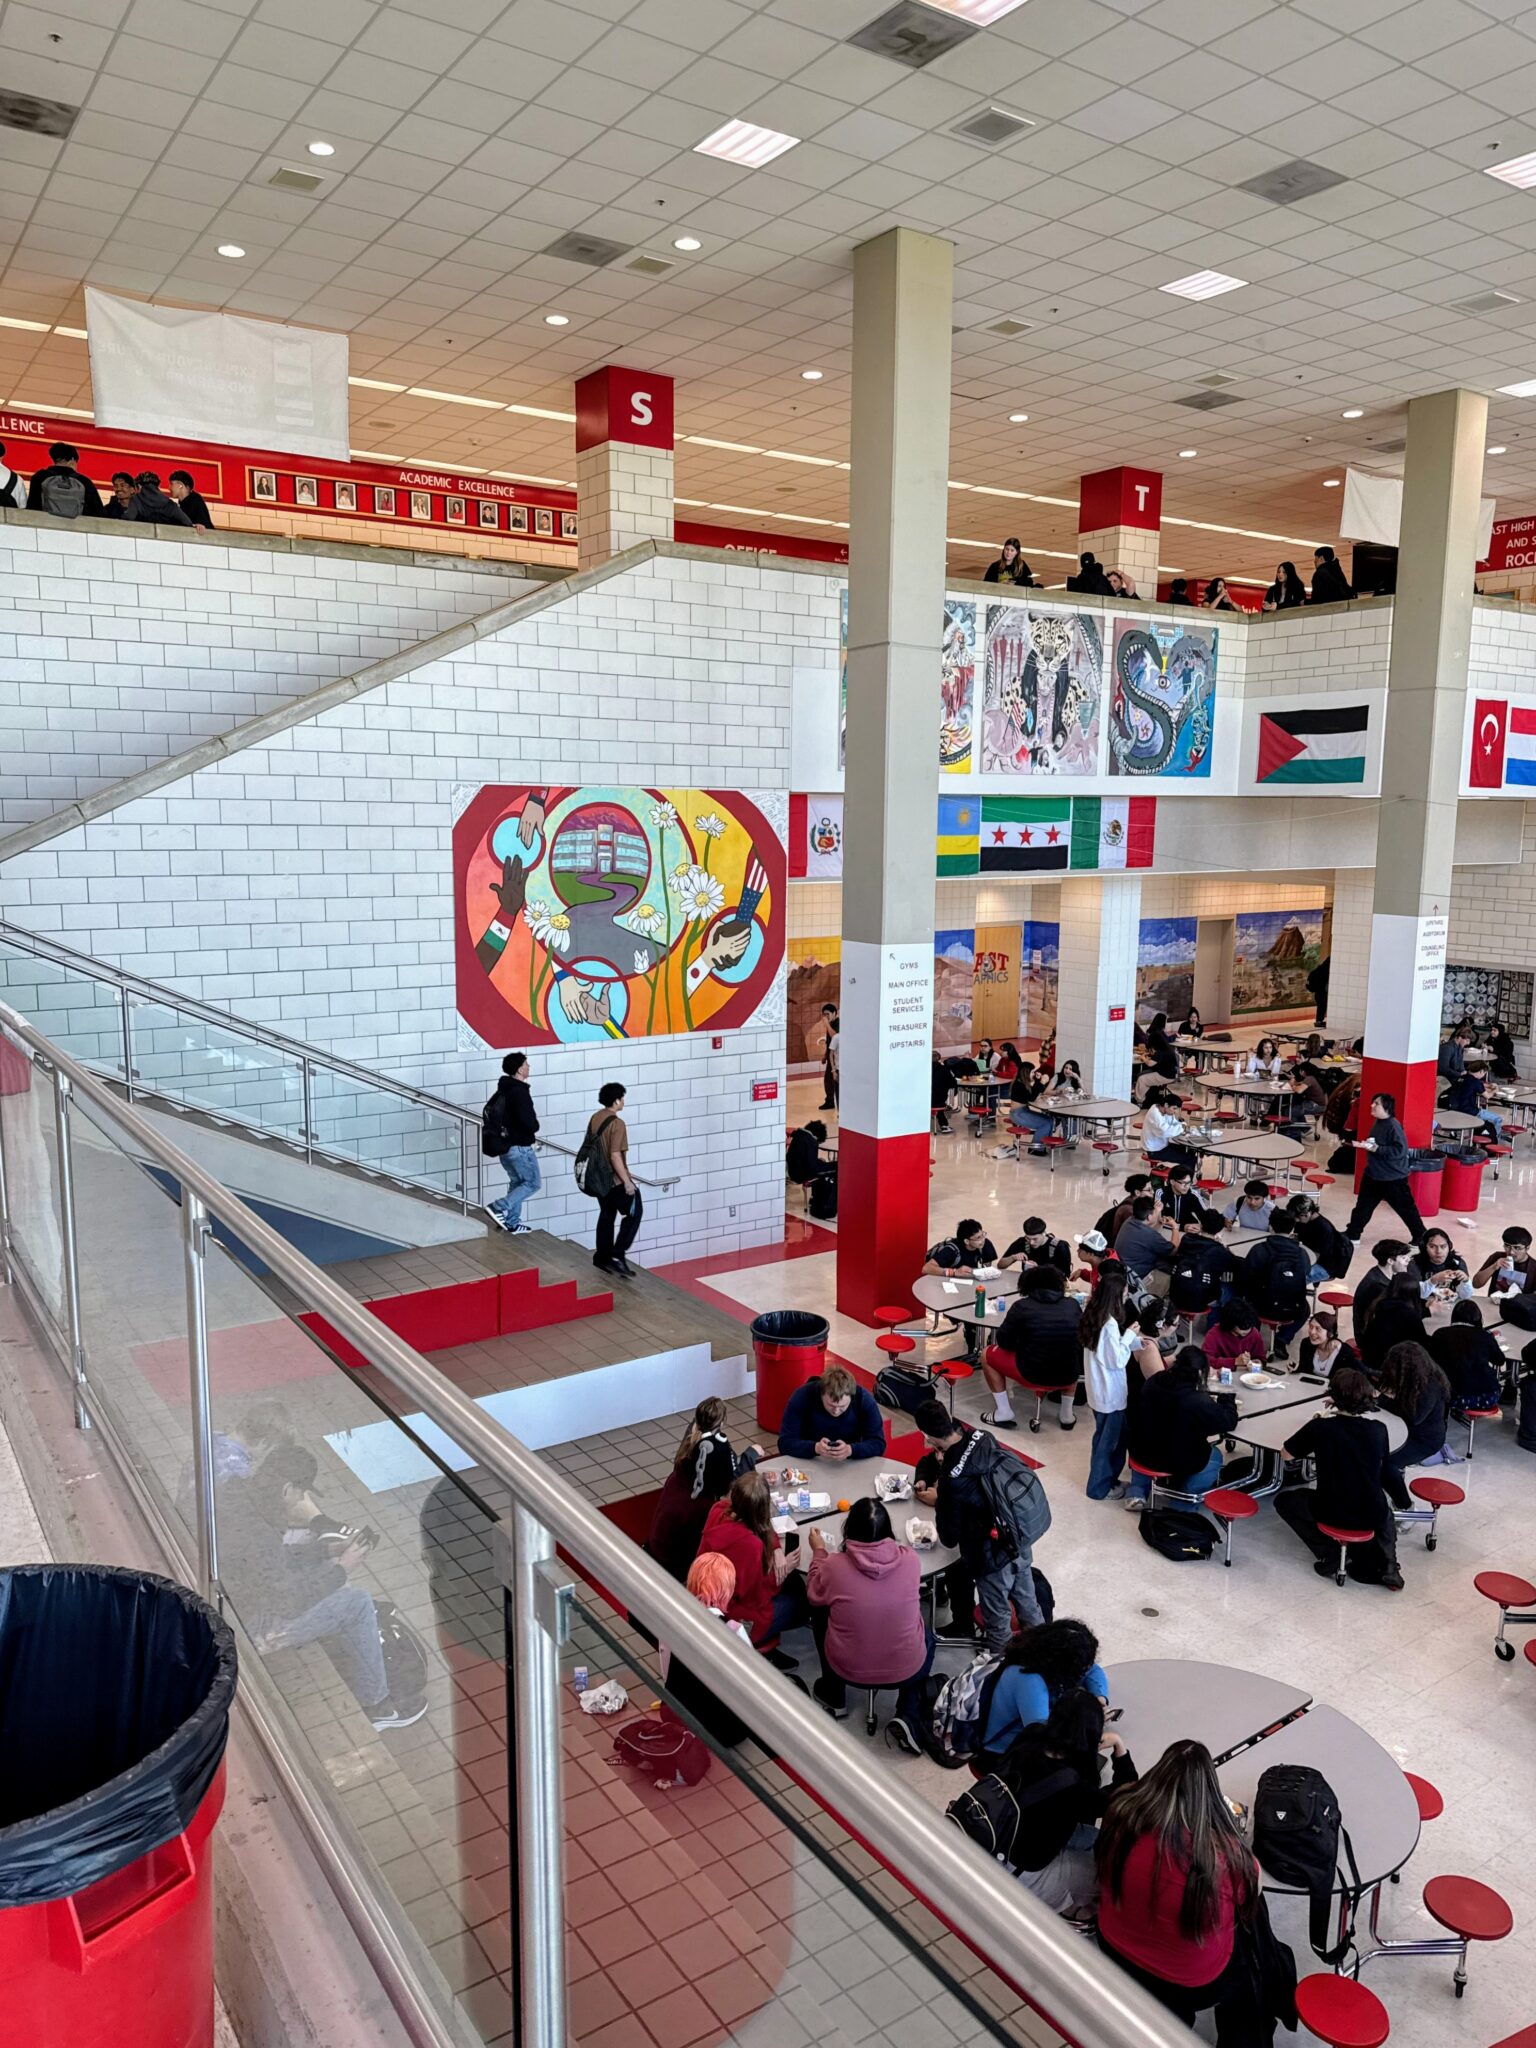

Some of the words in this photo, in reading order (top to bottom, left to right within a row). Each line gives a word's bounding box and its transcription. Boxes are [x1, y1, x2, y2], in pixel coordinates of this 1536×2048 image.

[631, 391, 653, 426] S
[0, 417, 45, 434] LENCE
[399, 471, 453, 489] ACADEMIC
[458, 480, 515, 498] EXCELLENCE
[1135, 485, 1150, 512] T
[1492, 524, 1508, 535] AST
[1511, 520, 1535, 533] HIGH
[1506, 537, 1528, 549] AND
[900, 962, 919, 970] GYMS
[973, 952, 1010, 973] AST
[888, 981, 904, 989] MAIN
[905, 979, 929, 988] OFFICE
[974, 972, 1009, 985] APHICS
[893, 996, 923, 1006] STUDENT
[892, 1005, 924, 1014] SERVICES
[888, 1022, 928, 1032] TREASURER
[889, 1039, 925, 1050] (UPSTAIRS)
